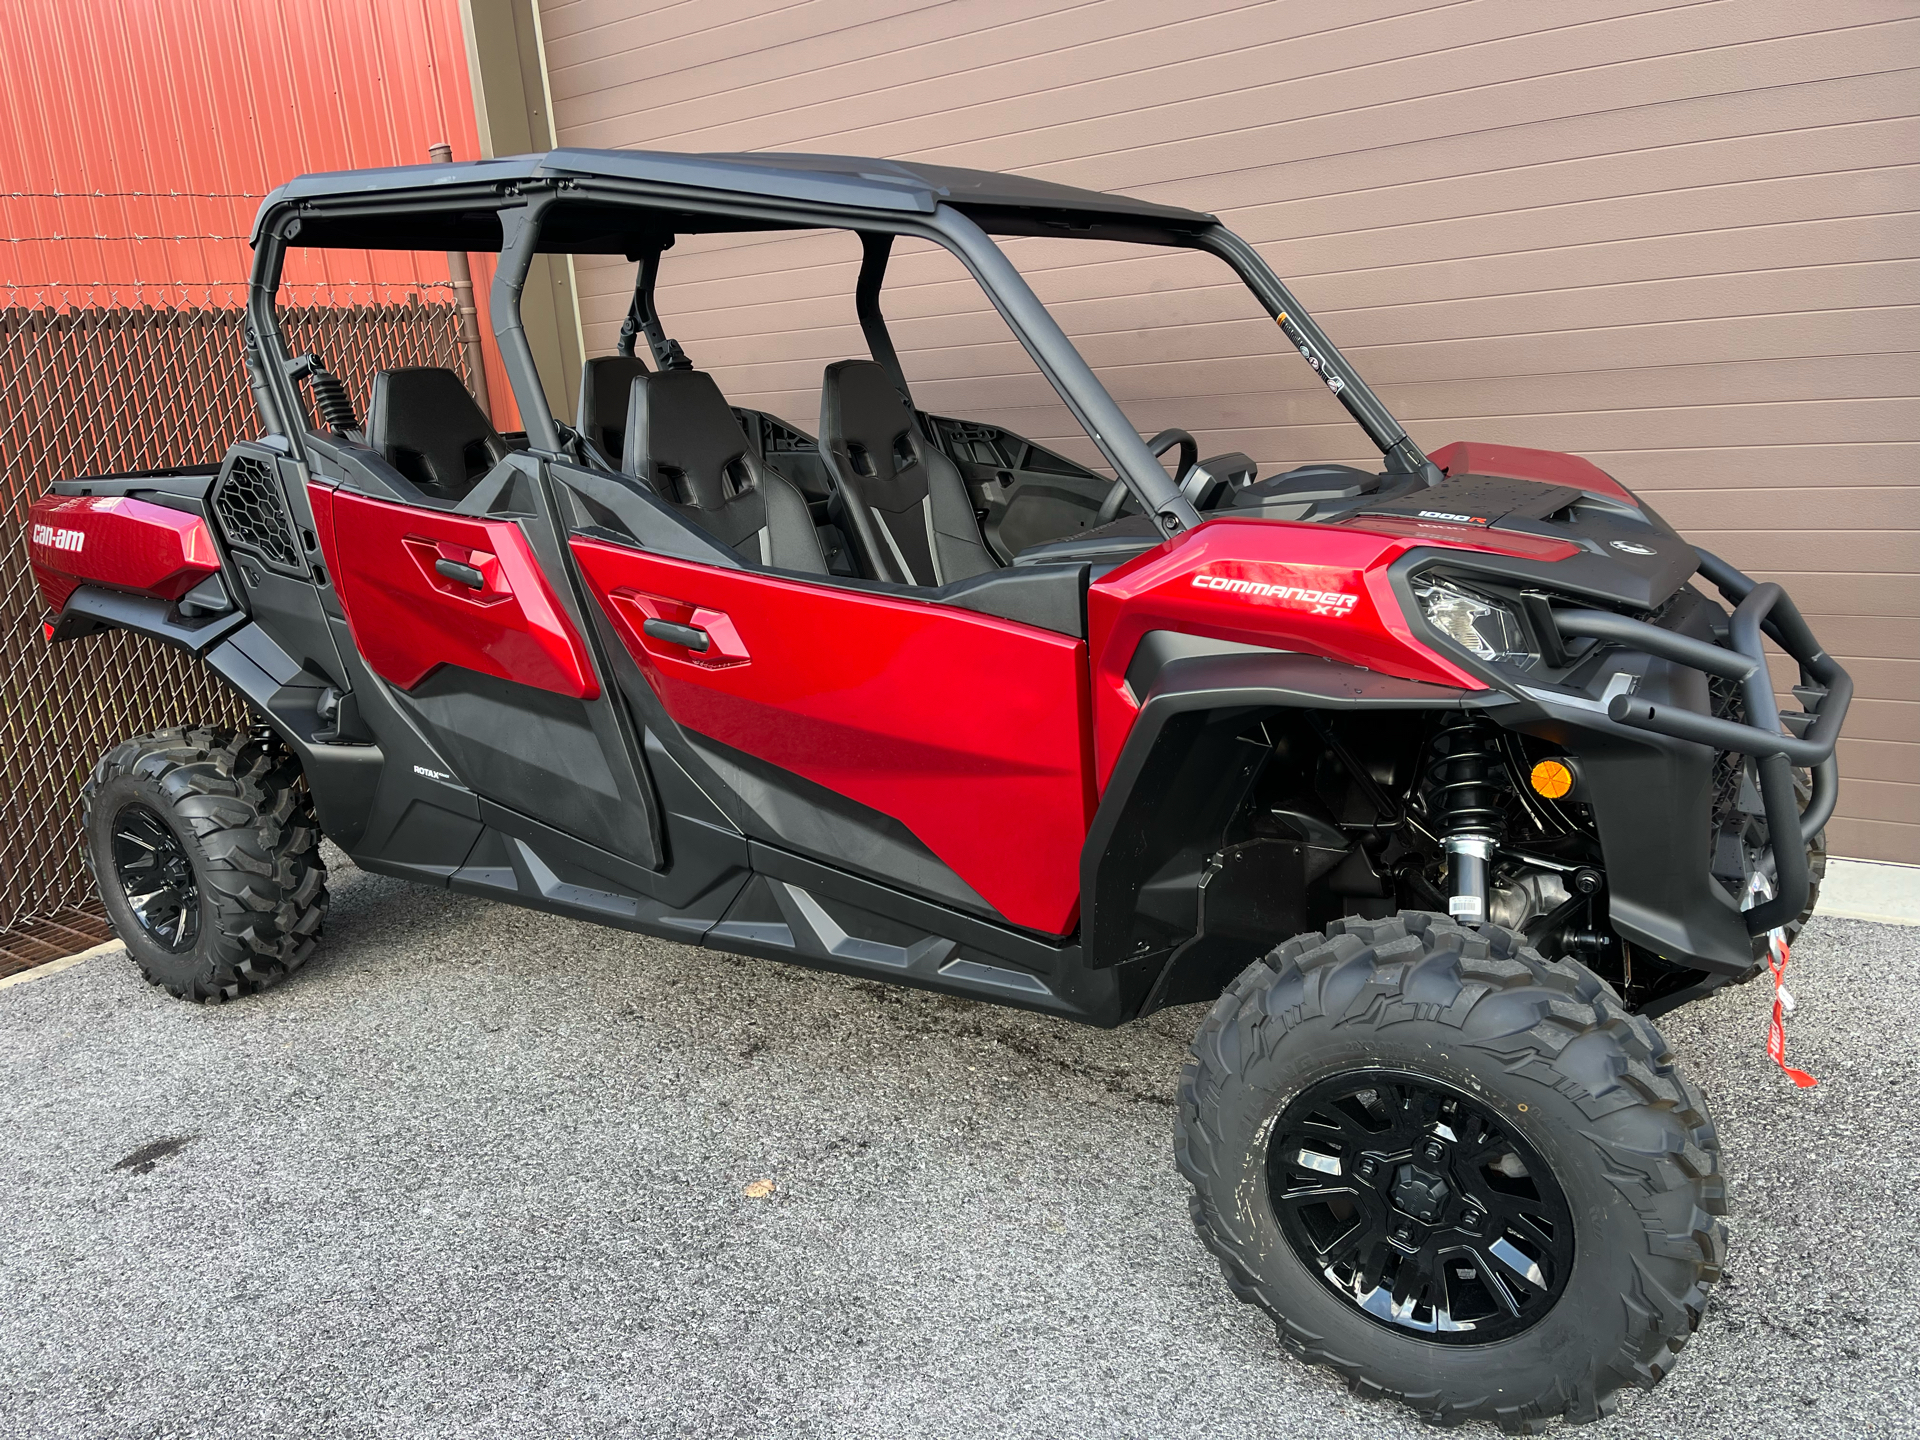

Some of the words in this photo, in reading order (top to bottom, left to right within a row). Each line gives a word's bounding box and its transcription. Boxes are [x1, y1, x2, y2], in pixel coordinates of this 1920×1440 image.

[1418, 510, 1487, 524] 1000R
[33, 524, 85, 552] can-am
[1192, 575, 1358, 607] COMMANDER
[1310, 605, 1351, 617] XT
[413, 765, 439, 779] ROTAX
